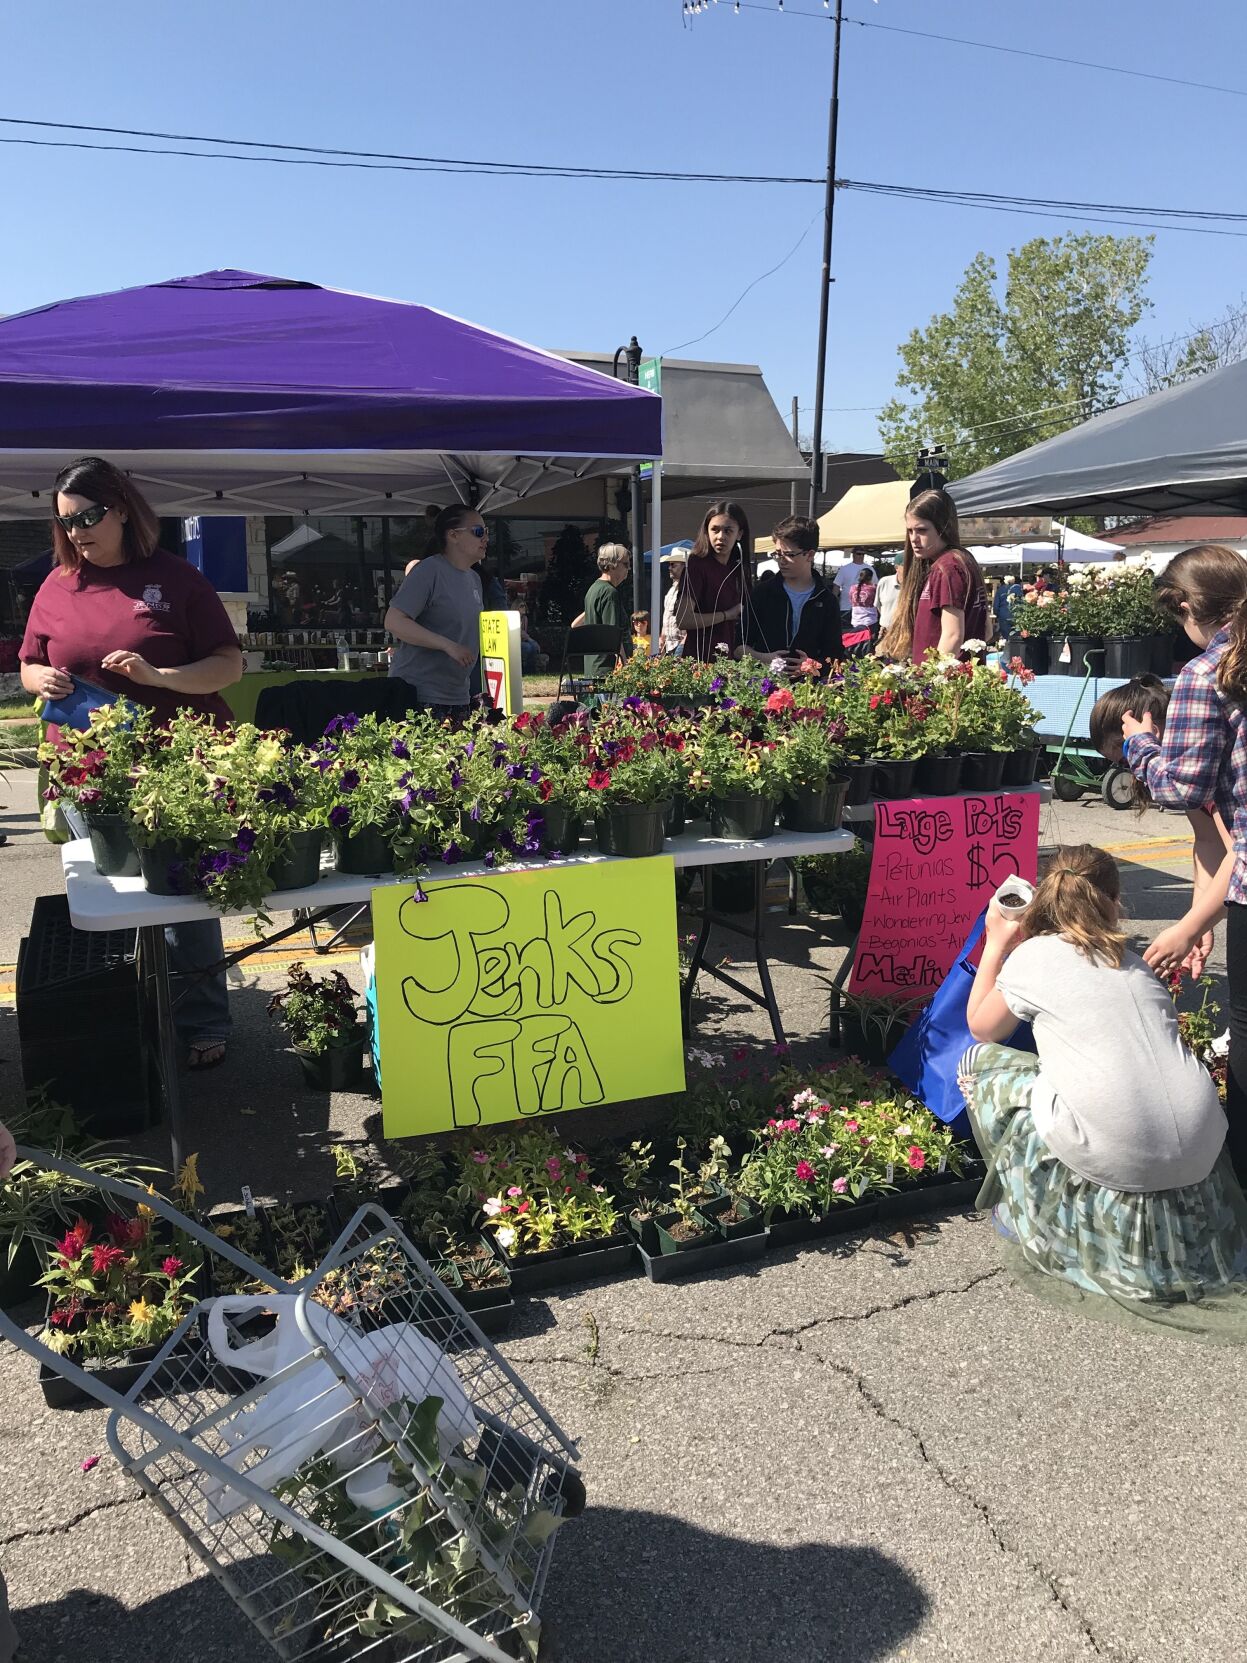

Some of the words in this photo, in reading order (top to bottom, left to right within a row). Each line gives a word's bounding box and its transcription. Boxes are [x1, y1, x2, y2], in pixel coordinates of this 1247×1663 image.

[482, 619, 501, 634] STATE
[485, 638, 497, 653] LAW
[878, 803, 954, 855] Large
[964, 796, 1024, 839] Pots
[966, 841, 1020, 890] $5
[907, 887, 957, 908] Plants
[946, 910, 972, 925] Jew
[399, 884, 642, 1026] Jenks
[856, 953, 951, 987] Mediu
[448, 1013, 606, 1129] FFA
